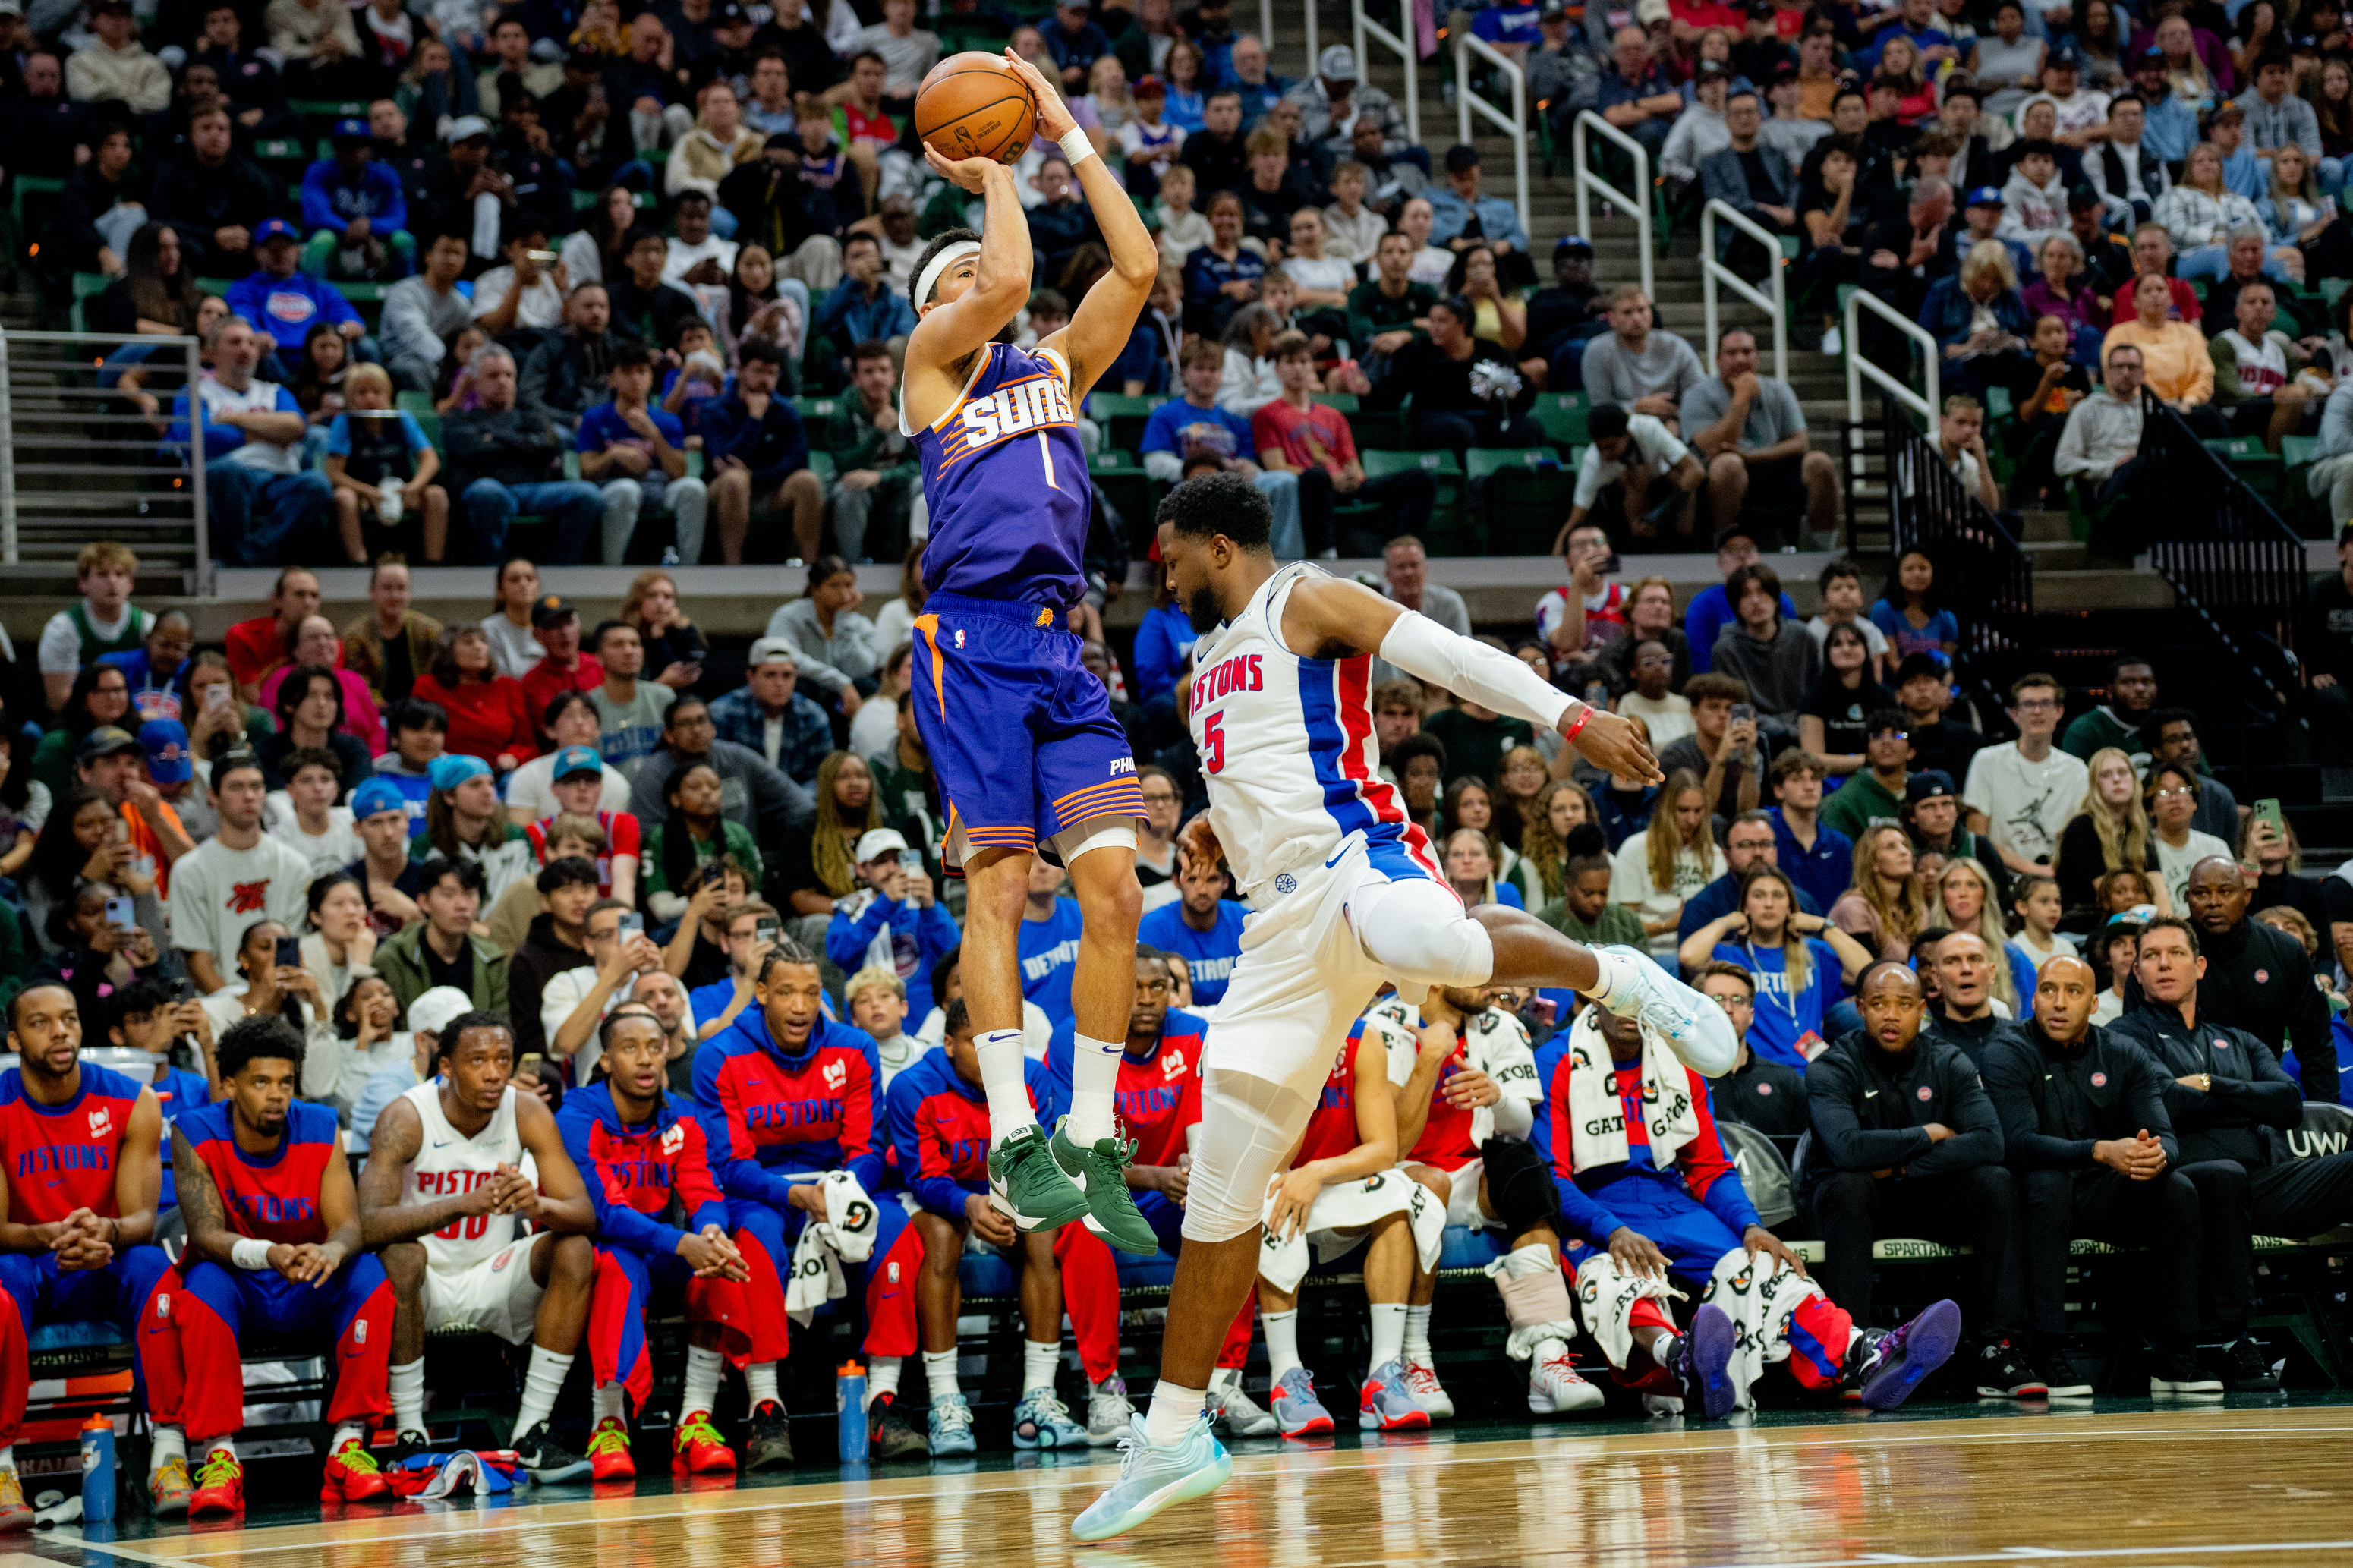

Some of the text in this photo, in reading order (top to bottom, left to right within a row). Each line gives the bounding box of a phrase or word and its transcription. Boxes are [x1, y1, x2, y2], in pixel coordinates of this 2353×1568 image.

[962, 379, 1074, 449] SUNS
[1037, 429, 1060, 490] 1
[1189, 654, 1263, 719] ISTONS
[1205, 710, 1224, 774] 5
[417, 1170, 499, 1195] PISTO
